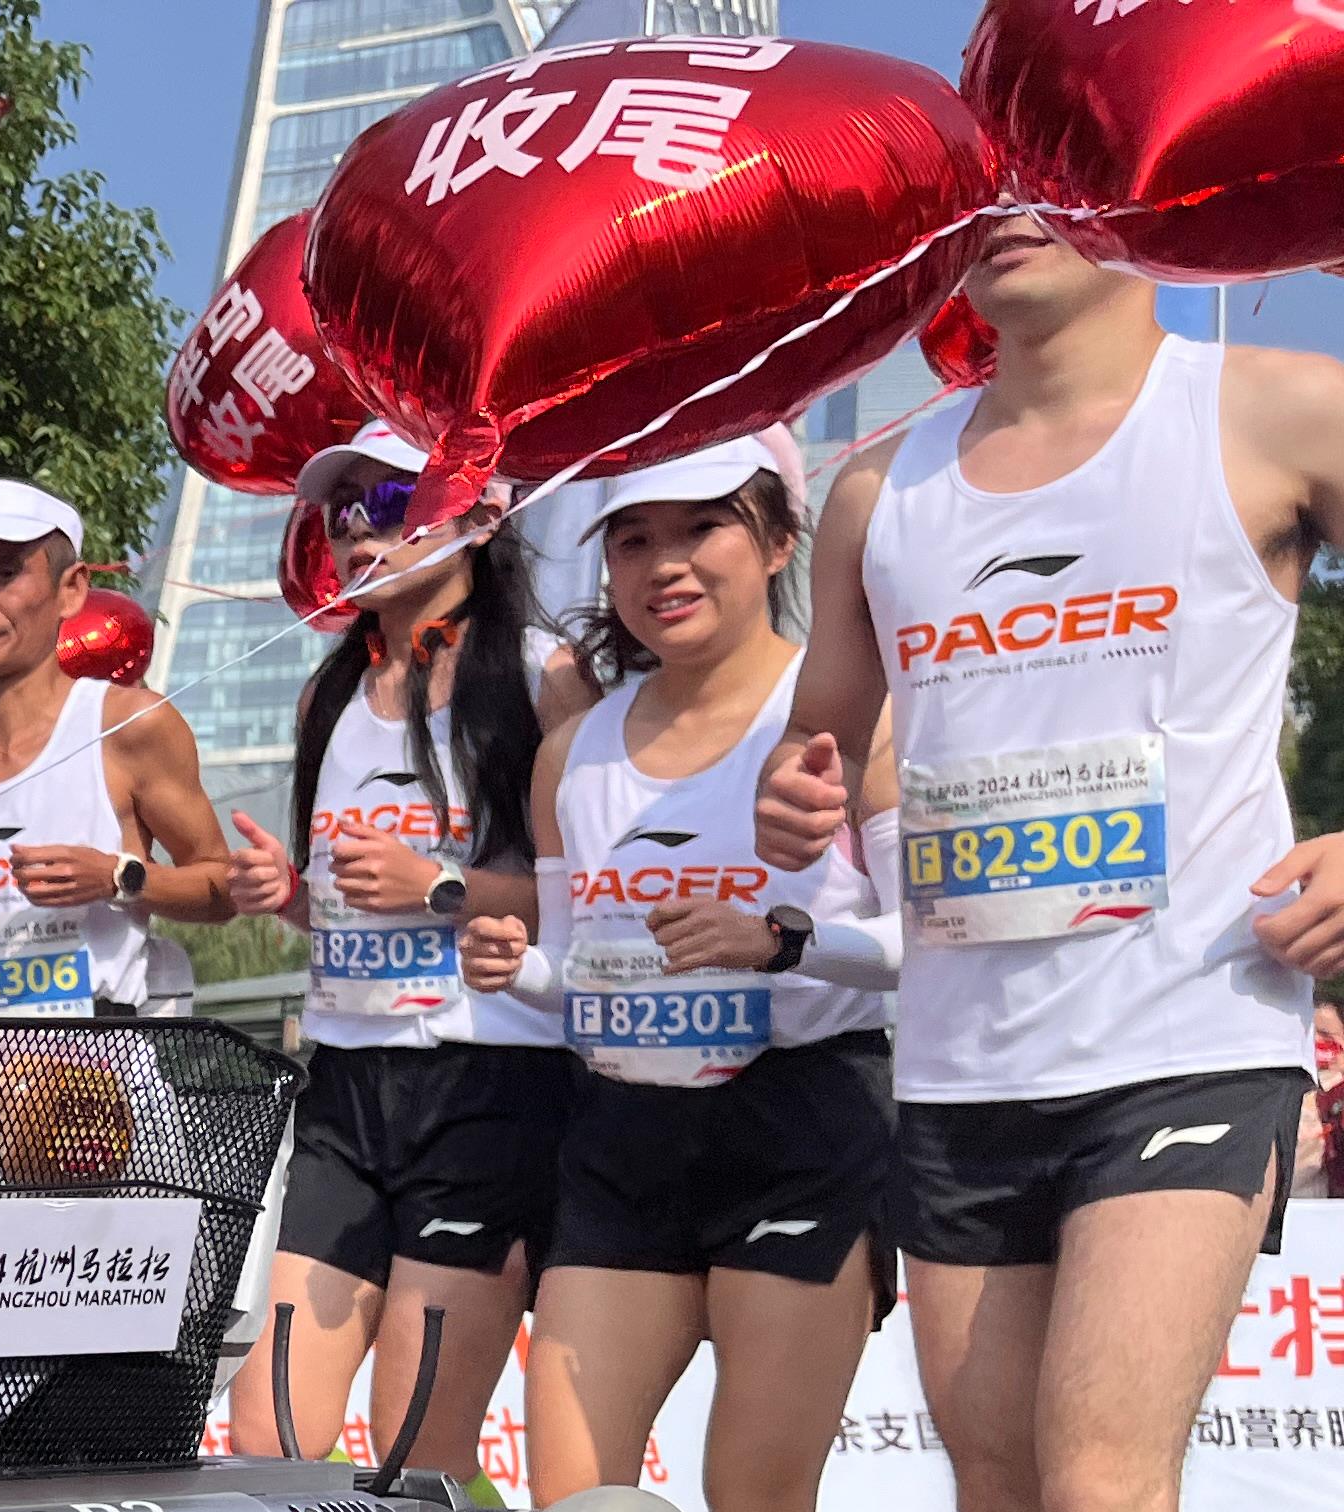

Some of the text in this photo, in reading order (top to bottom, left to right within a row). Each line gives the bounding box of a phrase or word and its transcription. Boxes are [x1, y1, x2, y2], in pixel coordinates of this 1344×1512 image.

[403, 77, 753, 207] 收尾
[895, 585, 1179, 672] PACER
[952, 810, 1147, 882] 82302
[328, 930, 444, 970] 82303
[610, 993, 754, 1038] 82301
[74, 1287, 167, 1307] MARATHON
